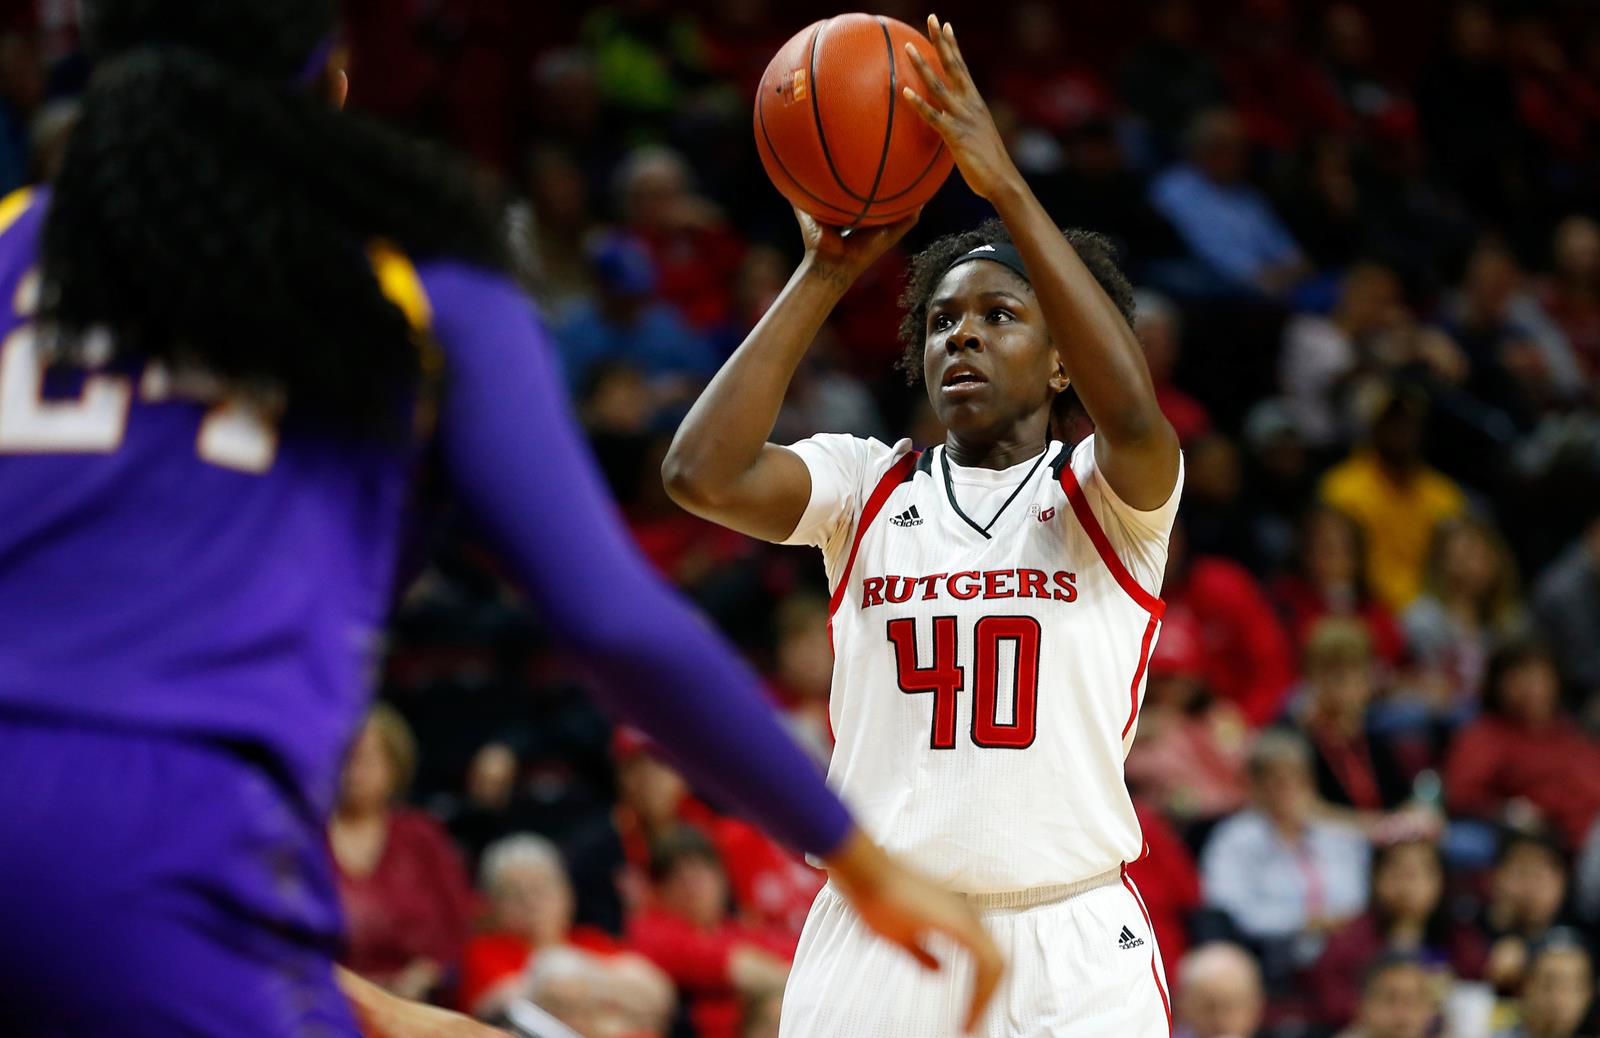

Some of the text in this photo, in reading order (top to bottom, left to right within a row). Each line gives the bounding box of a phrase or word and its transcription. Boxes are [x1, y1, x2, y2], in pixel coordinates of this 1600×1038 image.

[889, 517, 924, 528] adidas
[861, 568, 1078, 609] RUTGERS
[887, 615, 1042, 750] 40
